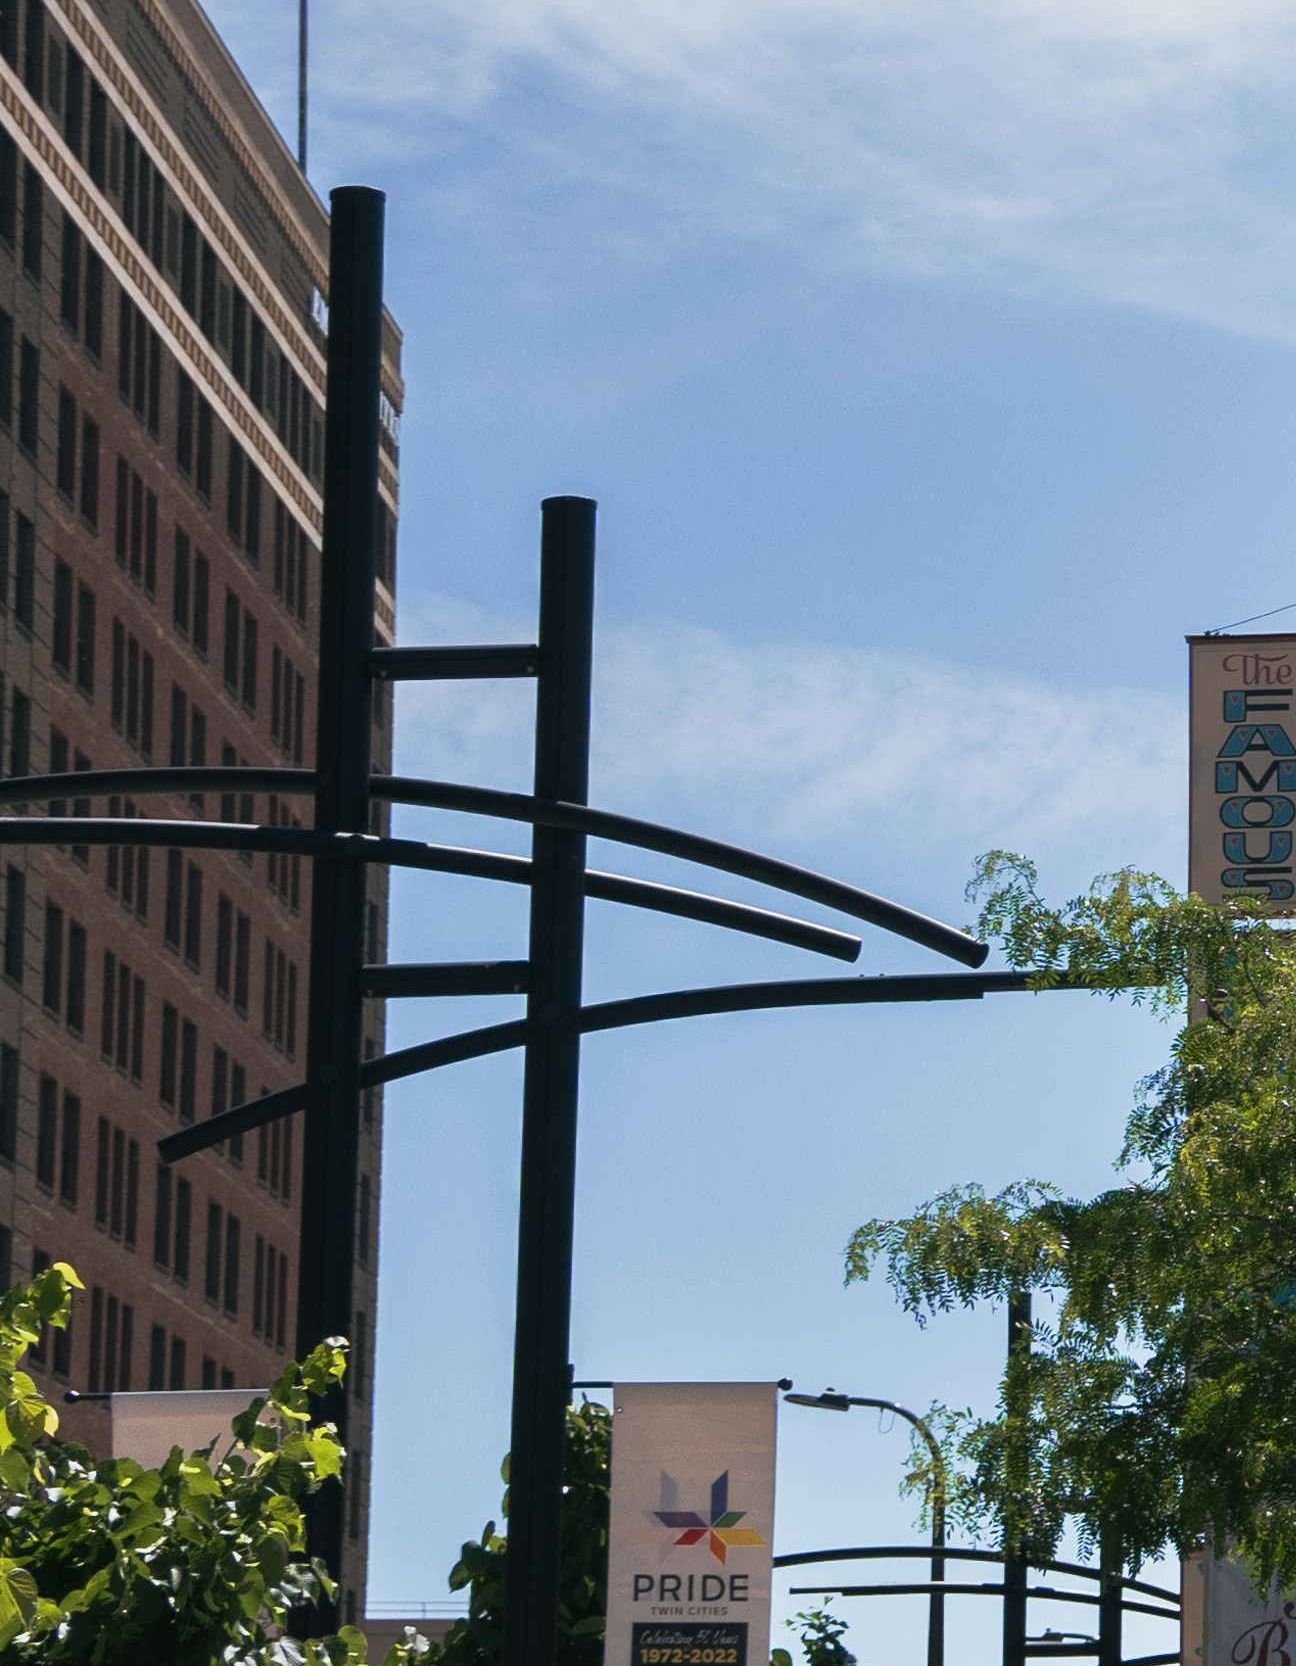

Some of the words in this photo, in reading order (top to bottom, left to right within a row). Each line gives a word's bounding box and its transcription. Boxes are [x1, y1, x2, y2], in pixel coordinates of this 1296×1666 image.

[1222, 653, 1294, 686] The
[632, 1573, 750, 1603] PRIDE
[651, 1606, 684, 1616] TWIN
[687, 1606, 729, 1616] CITIES
[640, 1648, 738, 1664] 1972-2022
